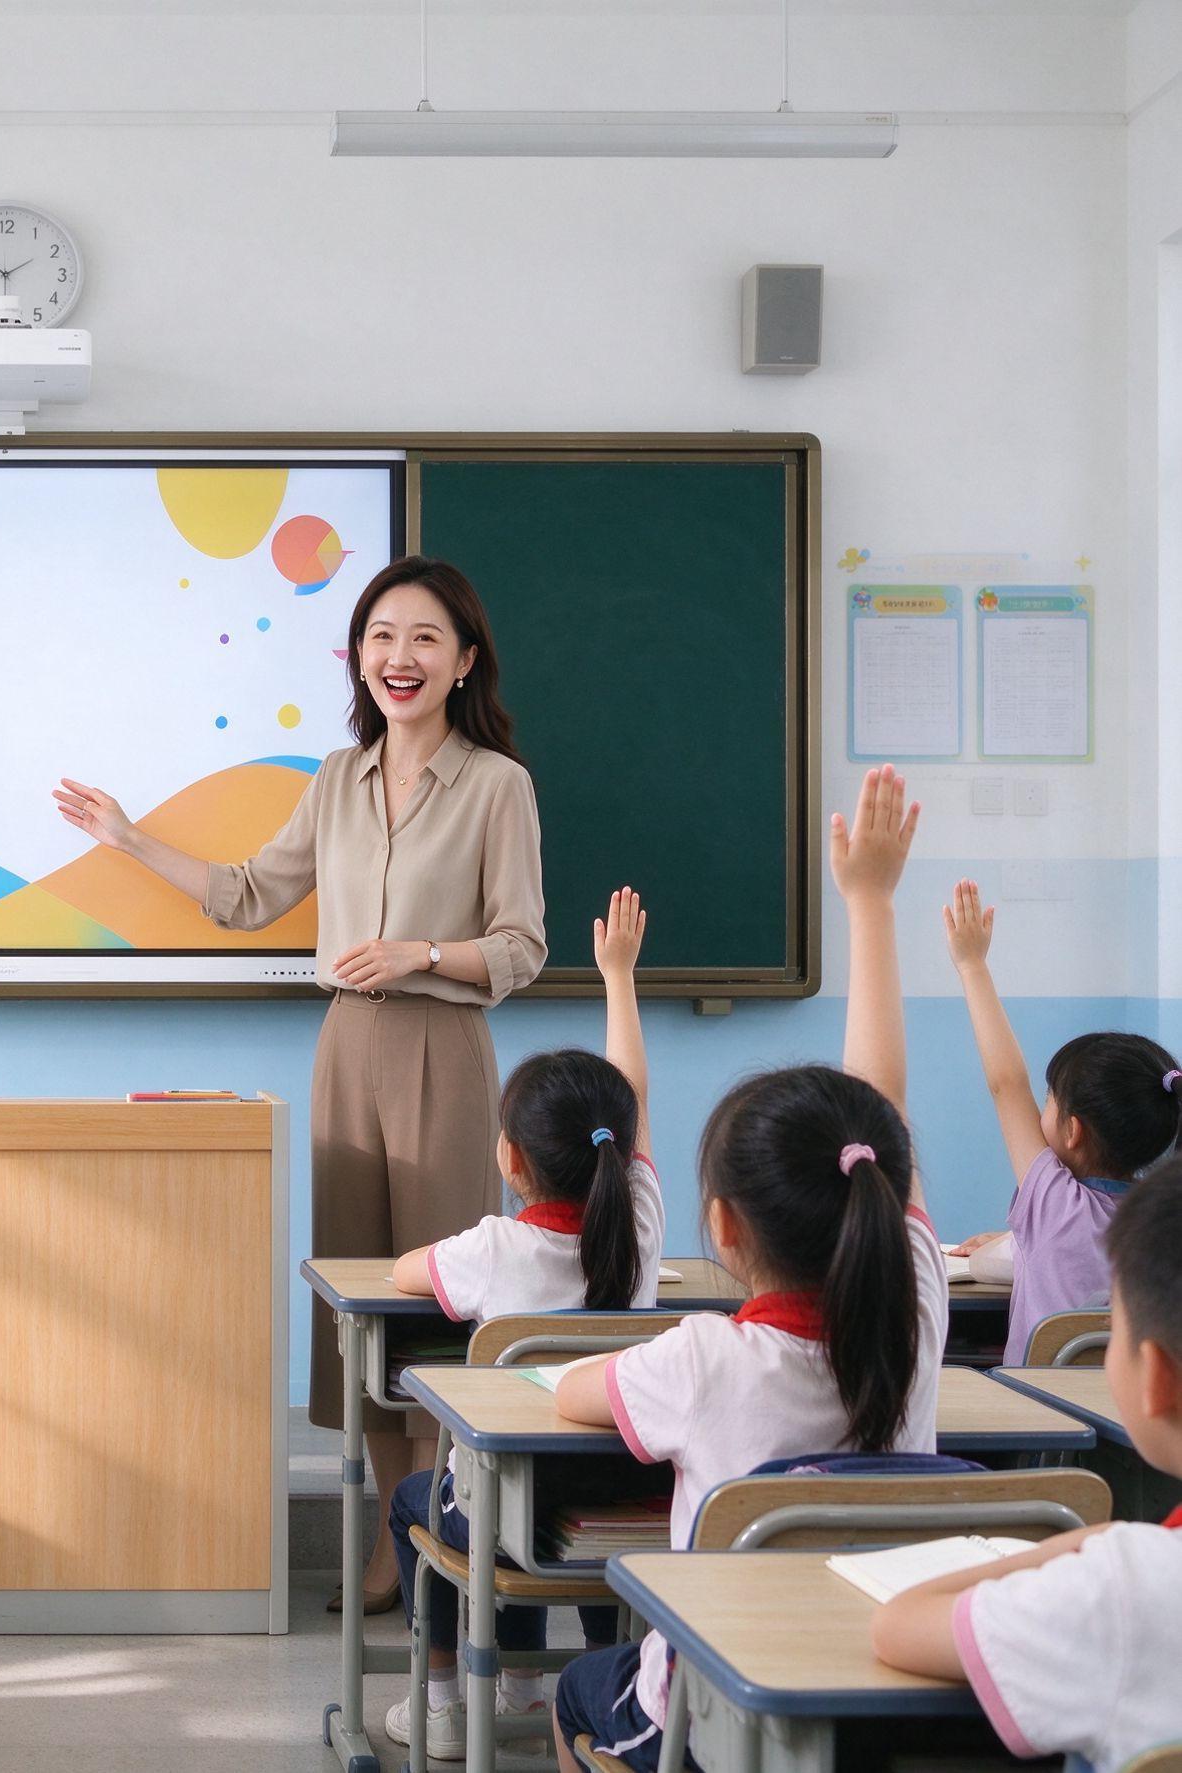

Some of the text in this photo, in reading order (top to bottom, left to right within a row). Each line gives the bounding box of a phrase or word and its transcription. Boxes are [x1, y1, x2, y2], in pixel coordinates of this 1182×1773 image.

[0, 219, 15, 234] 12
[32, 227, 37, 240] 1
[50, 244, 60, 259] 2
[58, 268, 67, 283] 3
[49, 292, 58, 305] 4
[33, 308, 43, 322] 5
